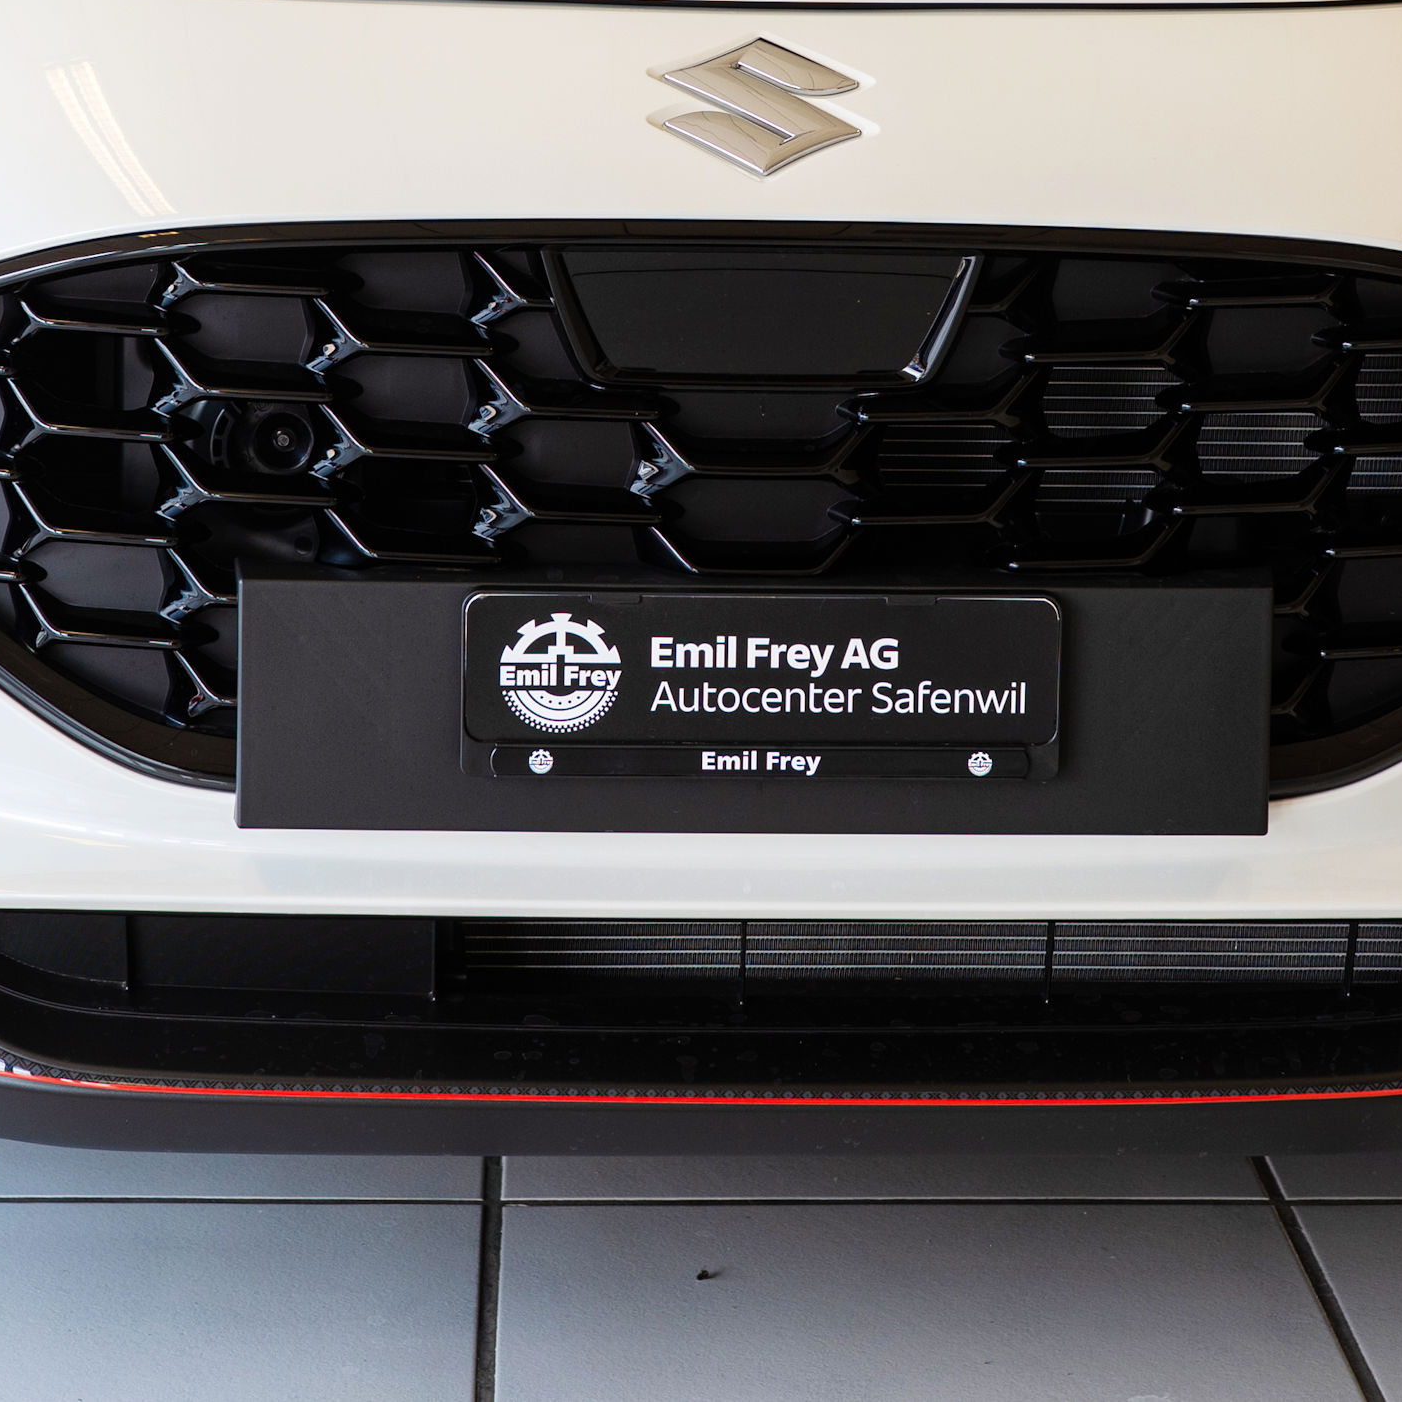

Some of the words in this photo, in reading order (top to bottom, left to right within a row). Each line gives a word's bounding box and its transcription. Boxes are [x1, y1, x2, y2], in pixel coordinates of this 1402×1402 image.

[650, 635, 737, 668] Emil
[747, 638, 835, 678] Frey
[840, 638, 899, 669] AG
[499, 663, 557, 687] Emil
[564, 665, 622, 690] Frey
[650, 680, 863, 713] Autocenter
[871, 680, 1027, 714] Safenwil
[701, 751, 758, 770] Emil
[766, 751, 821, 776] Frey
